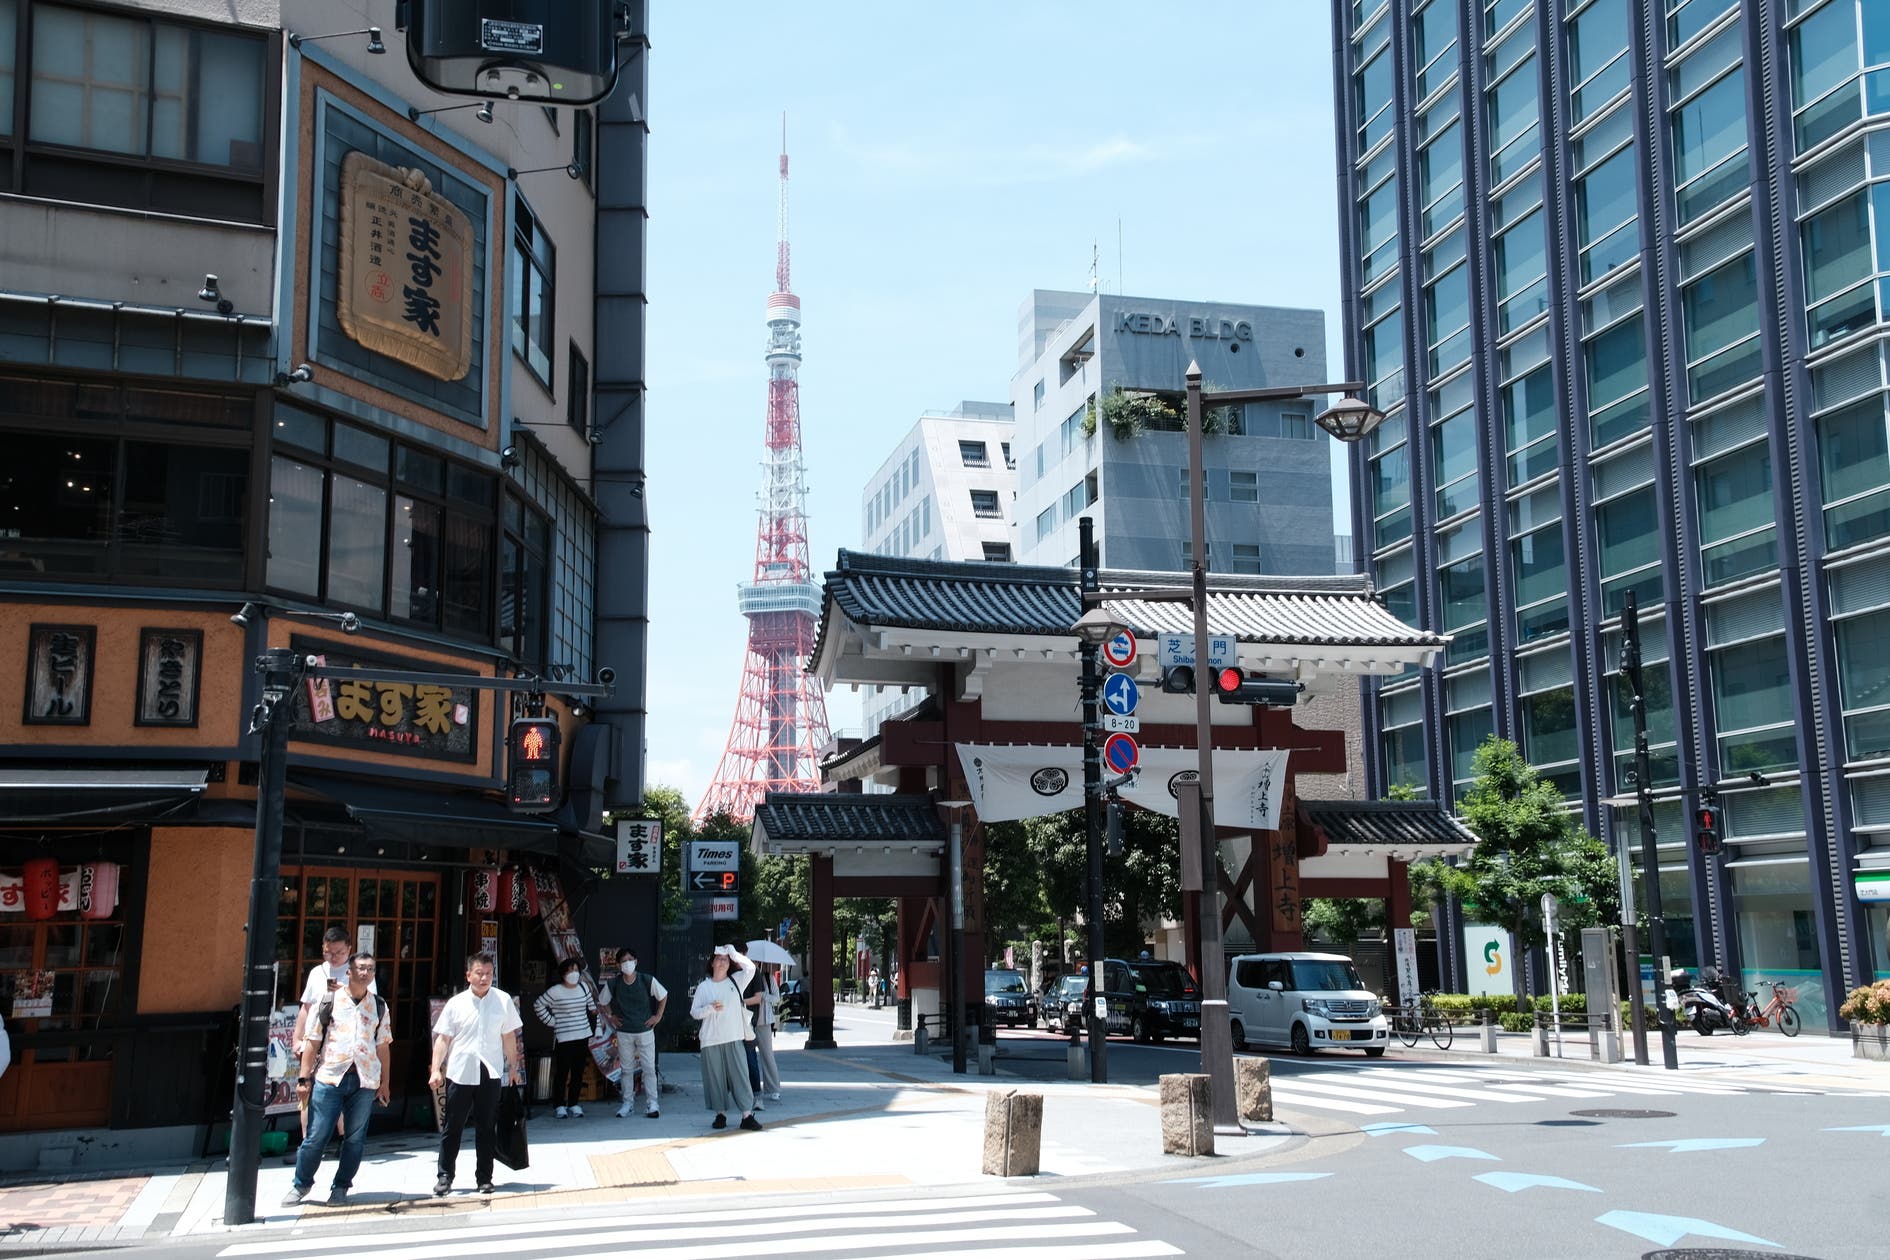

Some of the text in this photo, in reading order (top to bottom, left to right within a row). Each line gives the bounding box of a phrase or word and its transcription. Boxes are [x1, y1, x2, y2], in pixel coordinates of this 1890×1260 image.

[369, 215, 383, 267] 正井酒造
[402, 216, 442, 338] ます家
[1113, 311, 1253, 342] IKEDA BLDG
[47, 633, 78, 716] 生ビール
[158, 639, 184, 718] やきとり
[337, 663, 453, 734] ます家
[1111, 718, 1135, 730] 8-20
[627, 824, 648, 869] ます家
[697, 848, 733, 859] Times
[474, 872, 490, 910] 串焼
[723, 873, 735, 889] P
[1272, 842, 1297, 921] 増上寺
